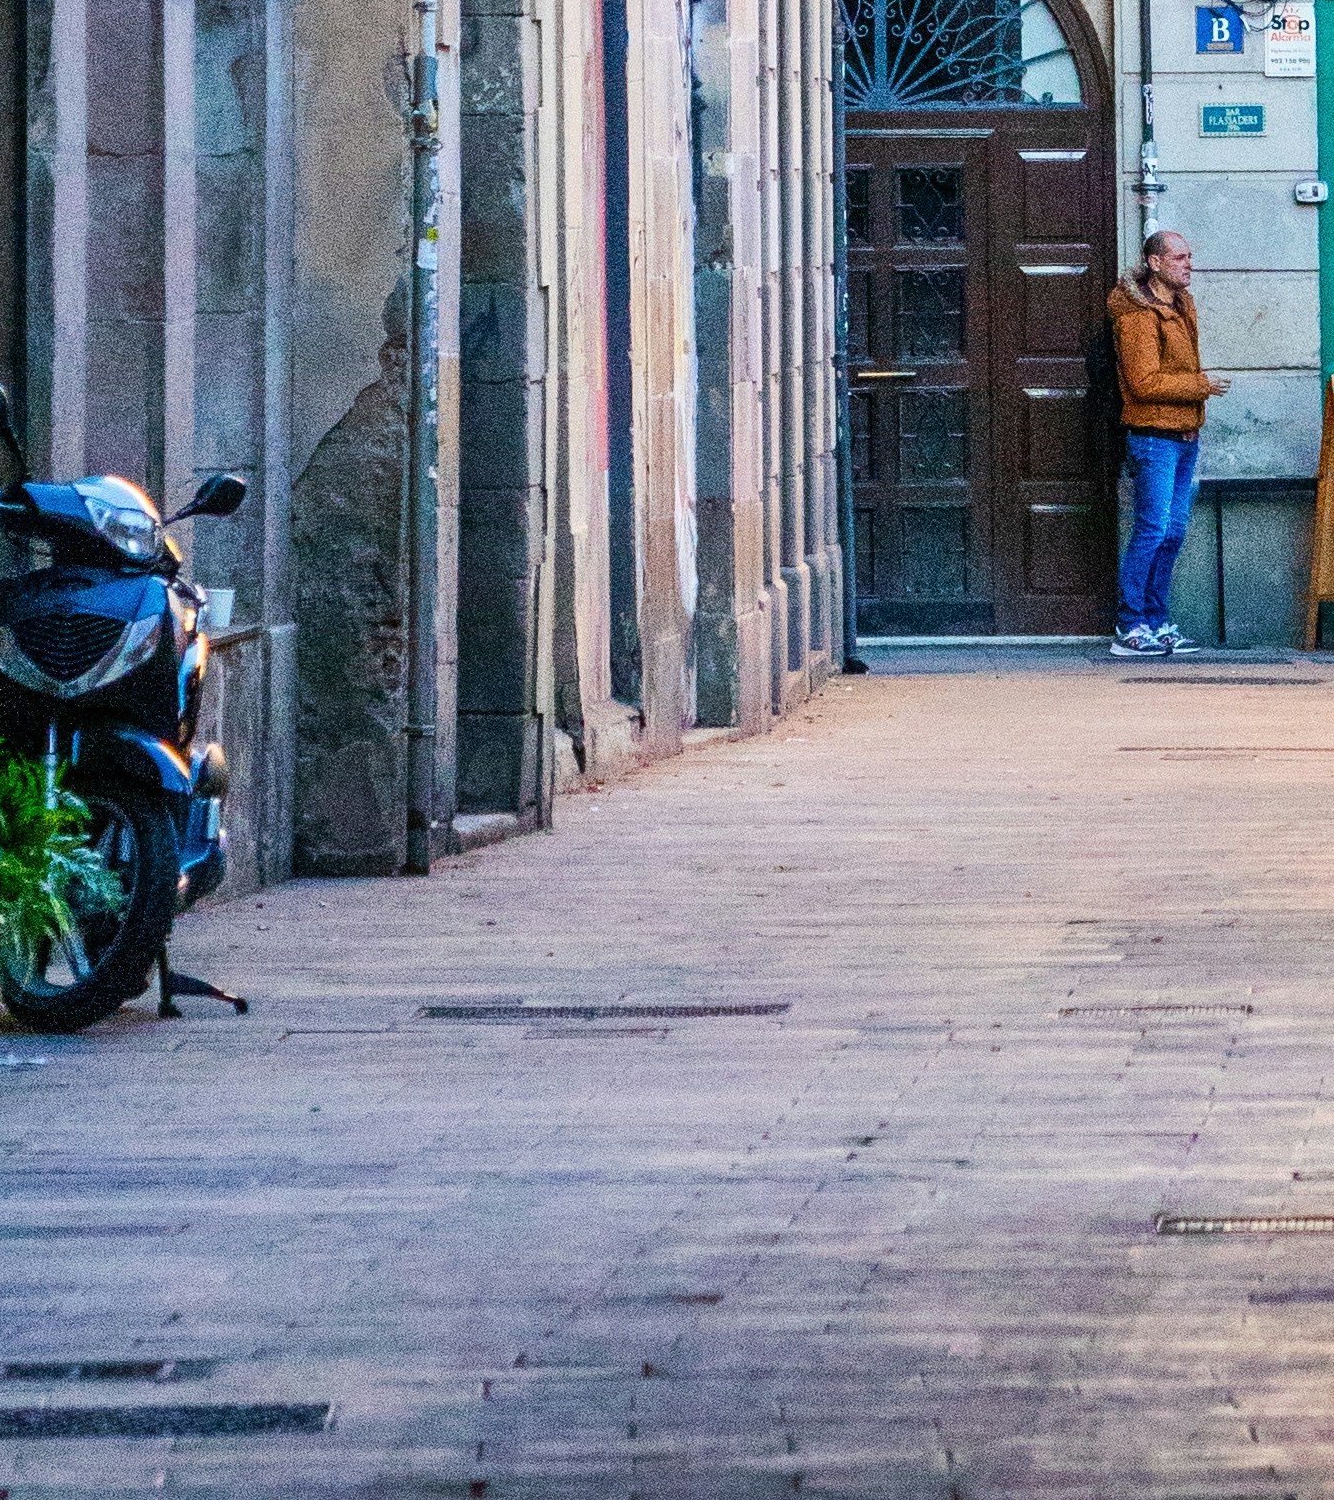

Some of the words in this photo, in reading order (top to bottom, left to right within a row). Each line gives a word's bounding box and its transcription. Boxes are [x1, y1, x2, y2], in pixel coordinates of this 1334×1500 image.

[1211, 17, 1230, 42] B
[1271, 15, 1310, 34] Stop
[1270, 32, 1311, 42] Alarma
